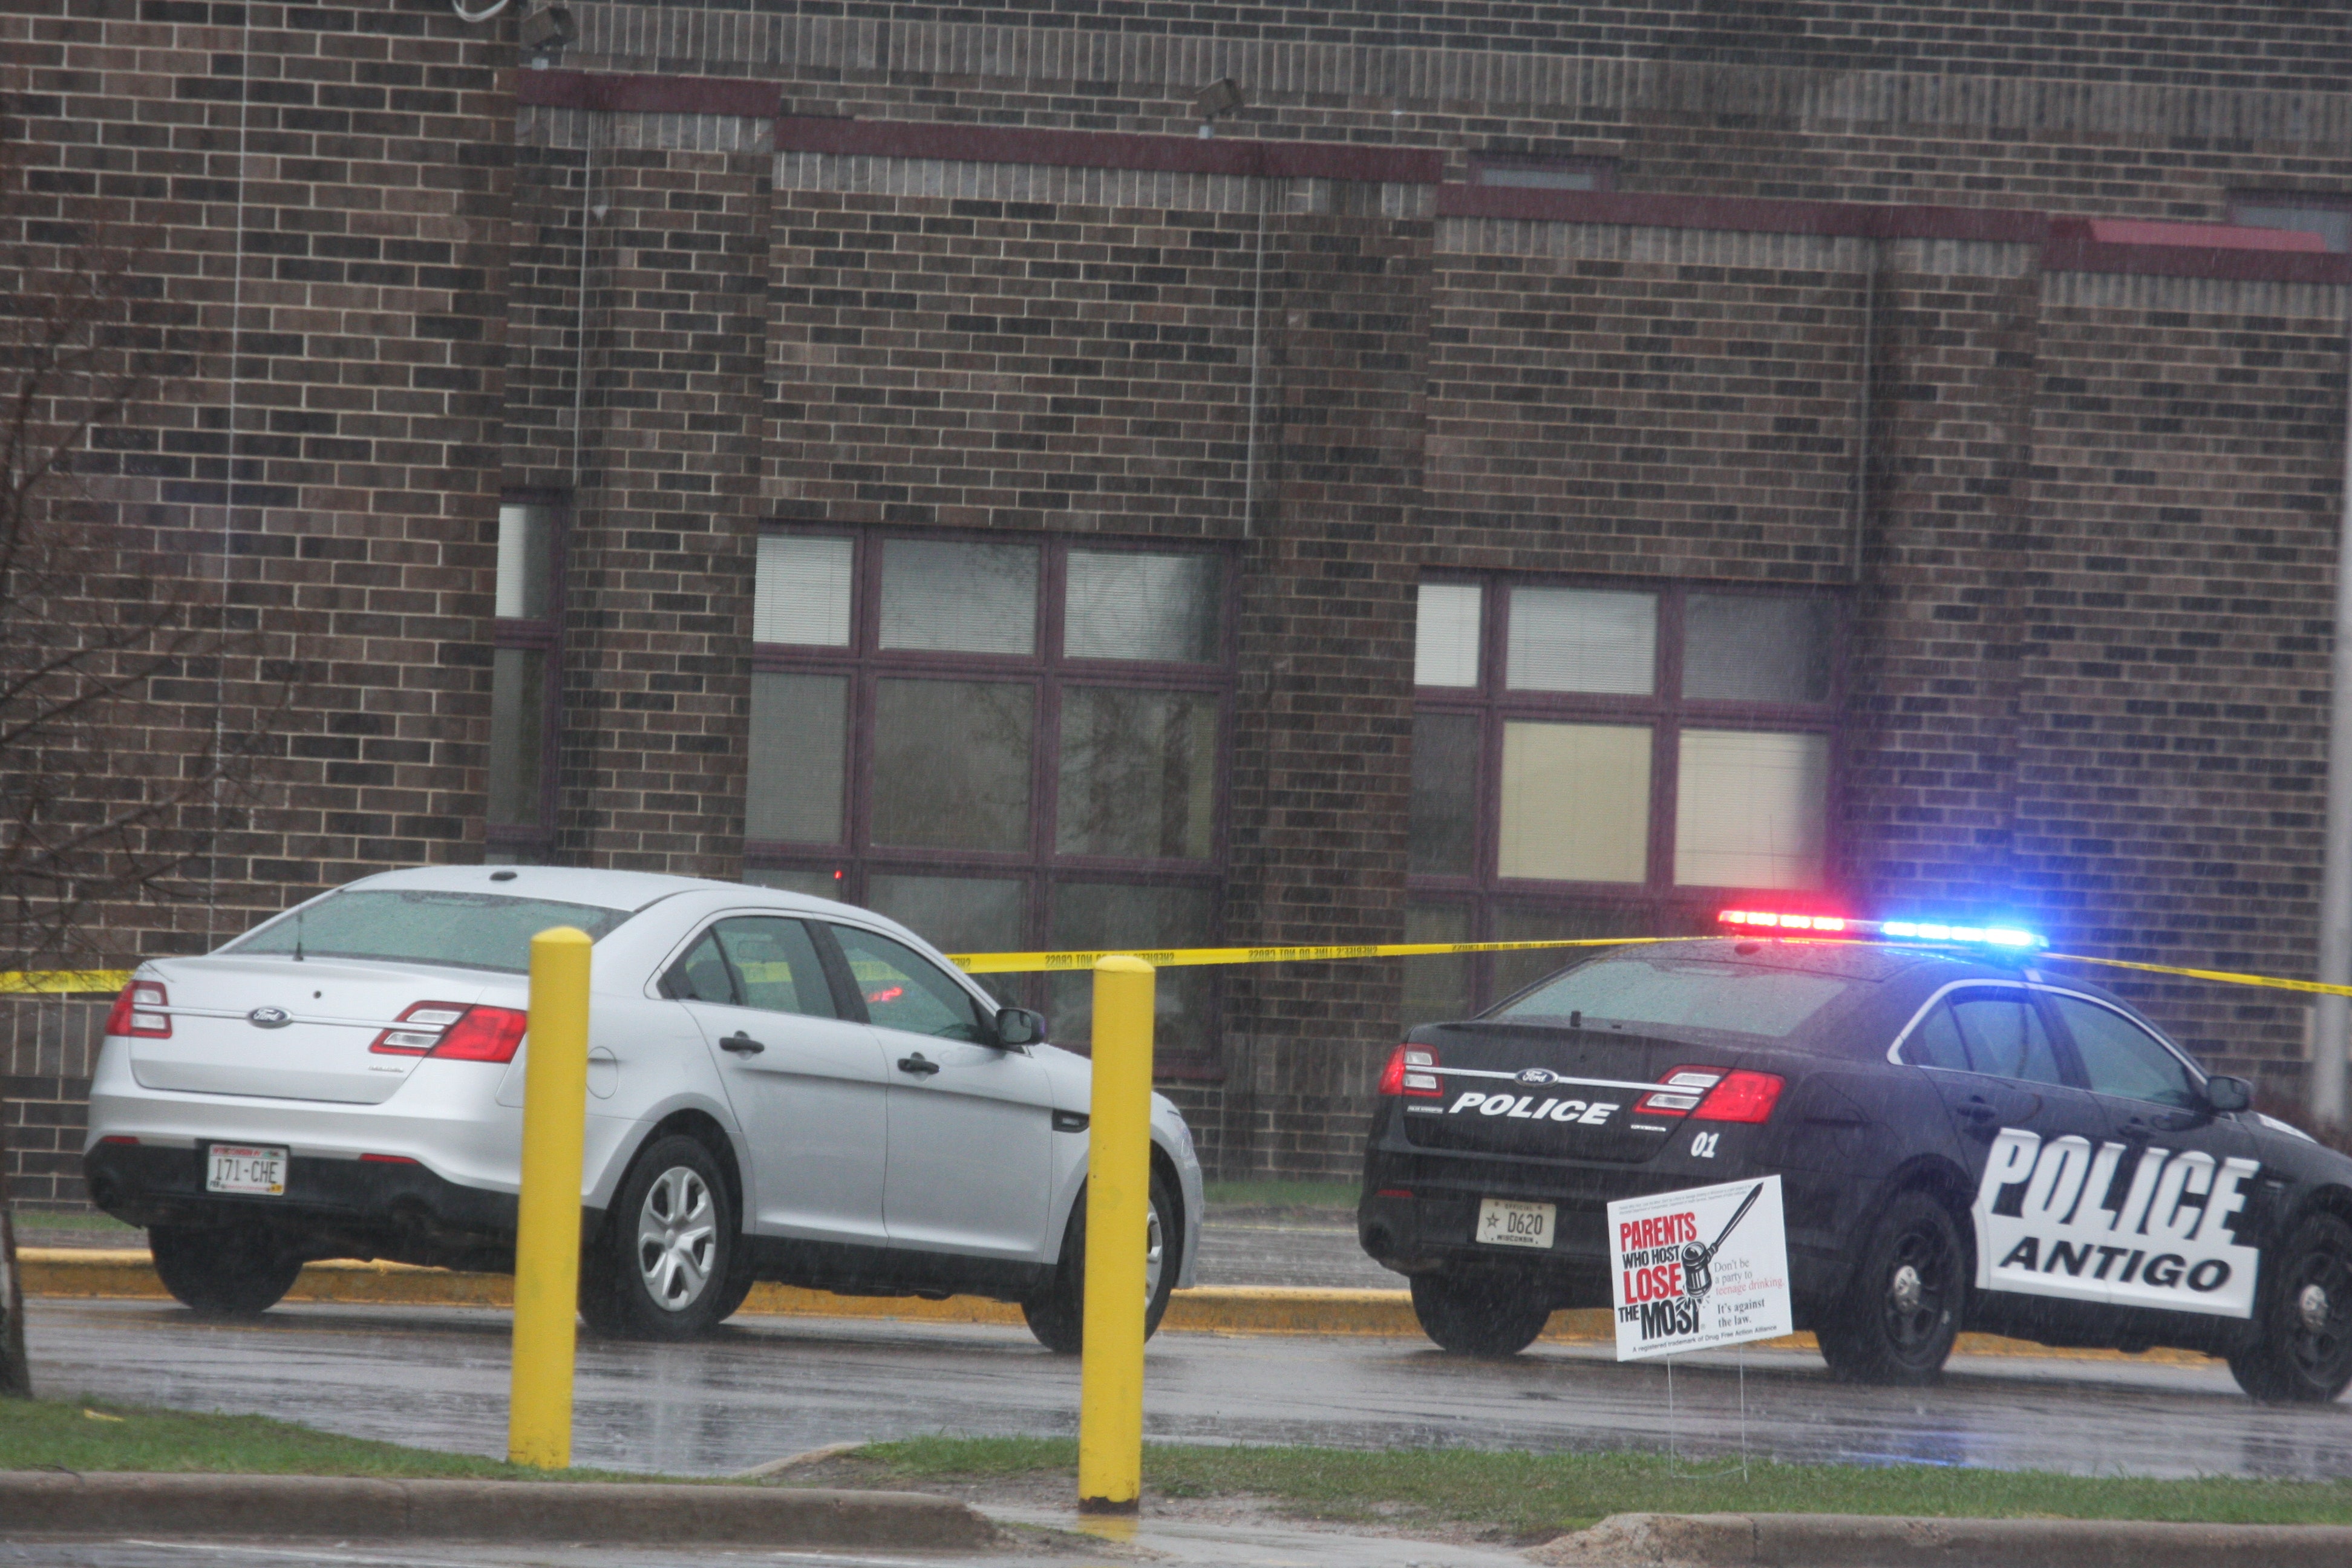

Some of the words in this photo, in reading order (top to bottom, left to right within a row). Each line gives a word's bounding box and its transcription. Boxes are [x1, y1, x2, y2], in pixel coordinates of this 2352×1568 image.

[1522, 1070, 1547, 1083] Ford
[1448, 1092, 1620, 1125] POLICE
[1690, 1132, 1719, 1158] 01
[215, 1158, 278, 1184] 171-CHE
[1976, 1127, 2261, 1246] POLICE
[1619, 1212, 1697, 1252] PARENTS
[1622, 1250, 1649, 1270] WHO
[1651, 1245, 1680, 1265] HOST
[1714, 1259, 1737, 1272] Don't
[1739, 1258, 1749, 1268] be
[1998, 1236, 2232, 1292] ANTIGO
[1623, 1263, 1684, 1305] LOSE
[1716, 1284, 1746, 1295] teenage
[1722, 1272, 1742, 1286] party
[1718, 1302, 1731, 1314] It's
[1734, 1298, 1765, 1314] against
[1618, 1305, 1639, 1323] THE
[1639, 1299, 1699, 1341] MOST
[1719, 1317, 1731, 1328] the
[1734, 1315, 1751, 1326] law.
[1638, 1342, 1667, 1353] registered
[1668, 1338, 1696, 1347] trademark
